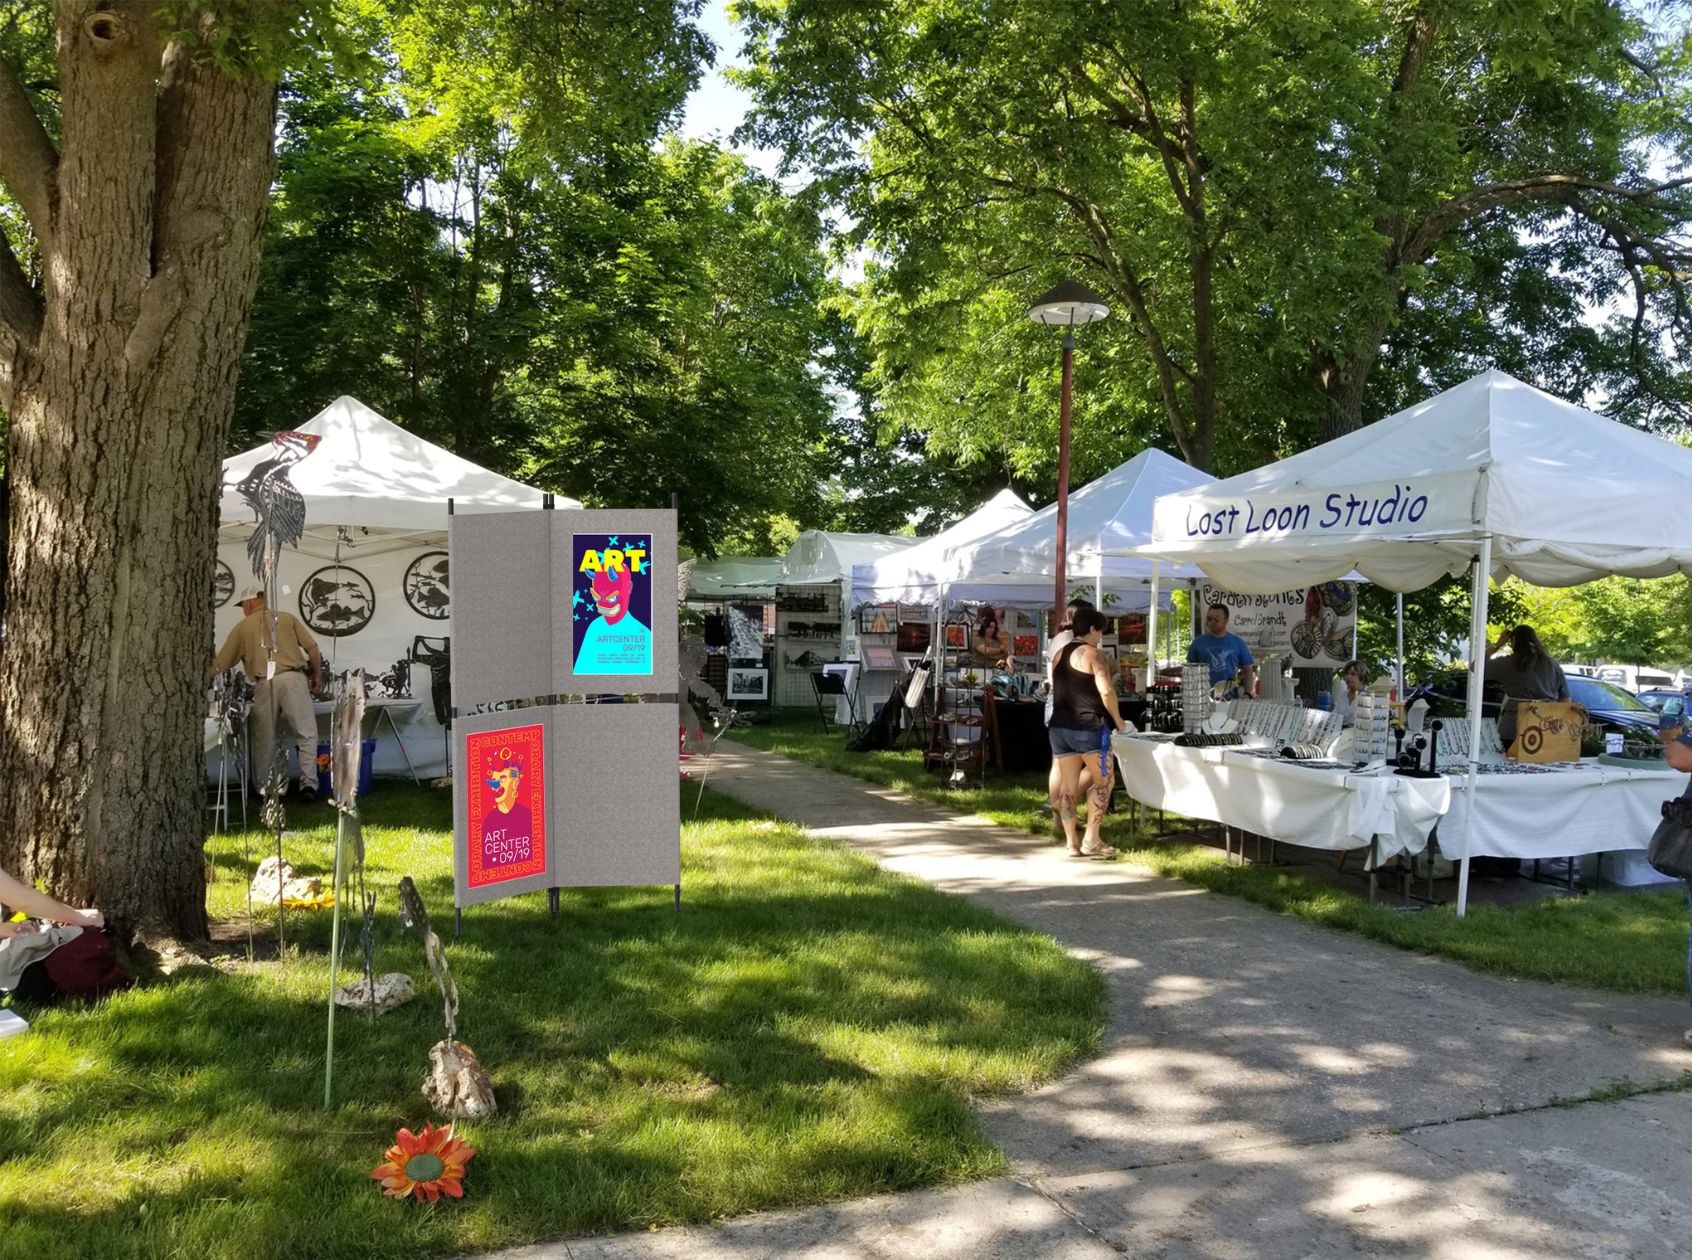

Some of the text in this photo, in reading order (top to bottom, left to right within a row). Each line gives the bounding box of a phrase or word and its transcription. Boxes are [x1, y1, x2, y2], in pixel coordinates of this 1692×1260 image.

[1186, 484, 1429, 537] Lost Loon Studio
[579, 549, 646, 573] ART
[597, 635, 646, 643] ARTCENTER
[622, 644, 646, 652] 09/19
[484, 829, 508, 844] ART
[484, 836, 530, 855] CENTER
[499, 848, 531, 864] 09/19
